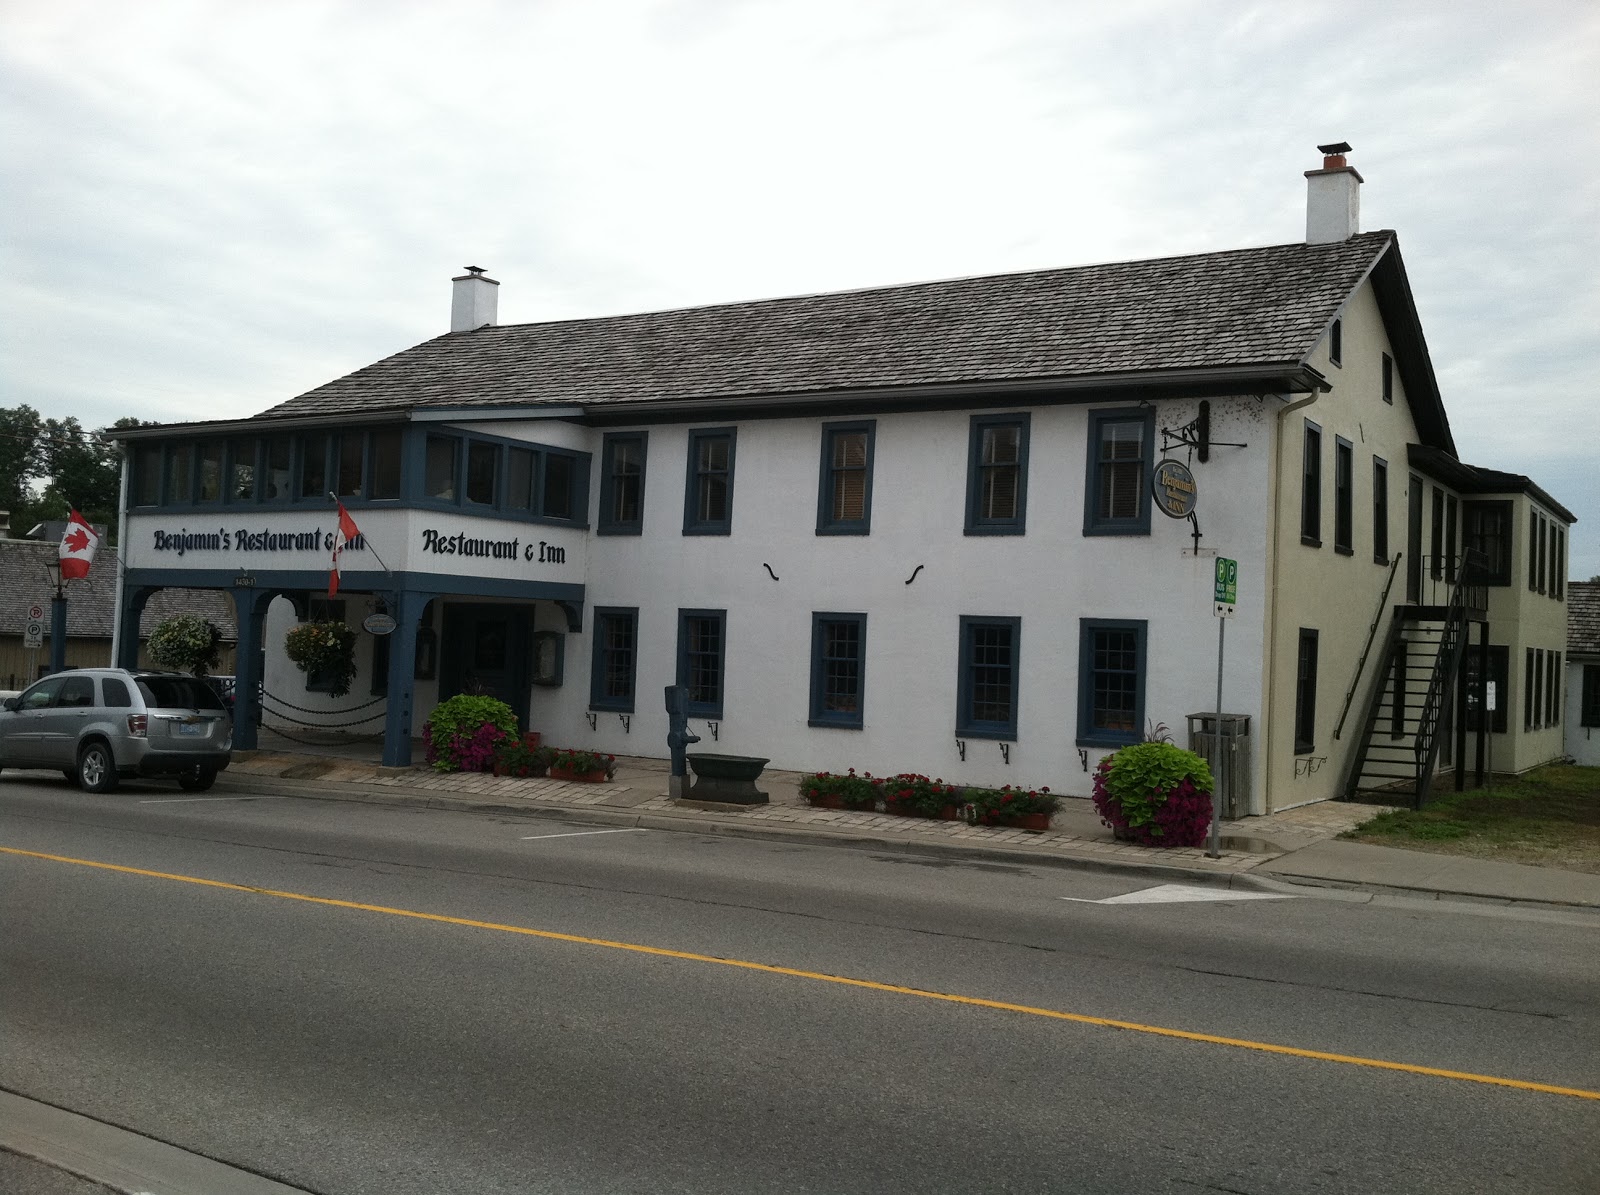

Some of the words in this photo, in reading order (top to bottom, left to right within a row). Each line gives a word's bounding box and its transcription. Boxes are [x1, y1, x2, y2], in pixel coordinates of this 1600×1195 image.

[153, 527, 230, 556] Benjamin's
[235, 527, 321, 551] Restaurant
[422, 529, 519, 560] Restaurant
[524, 543, 534, 562] &
[538, 541, 566, 564] Inn
